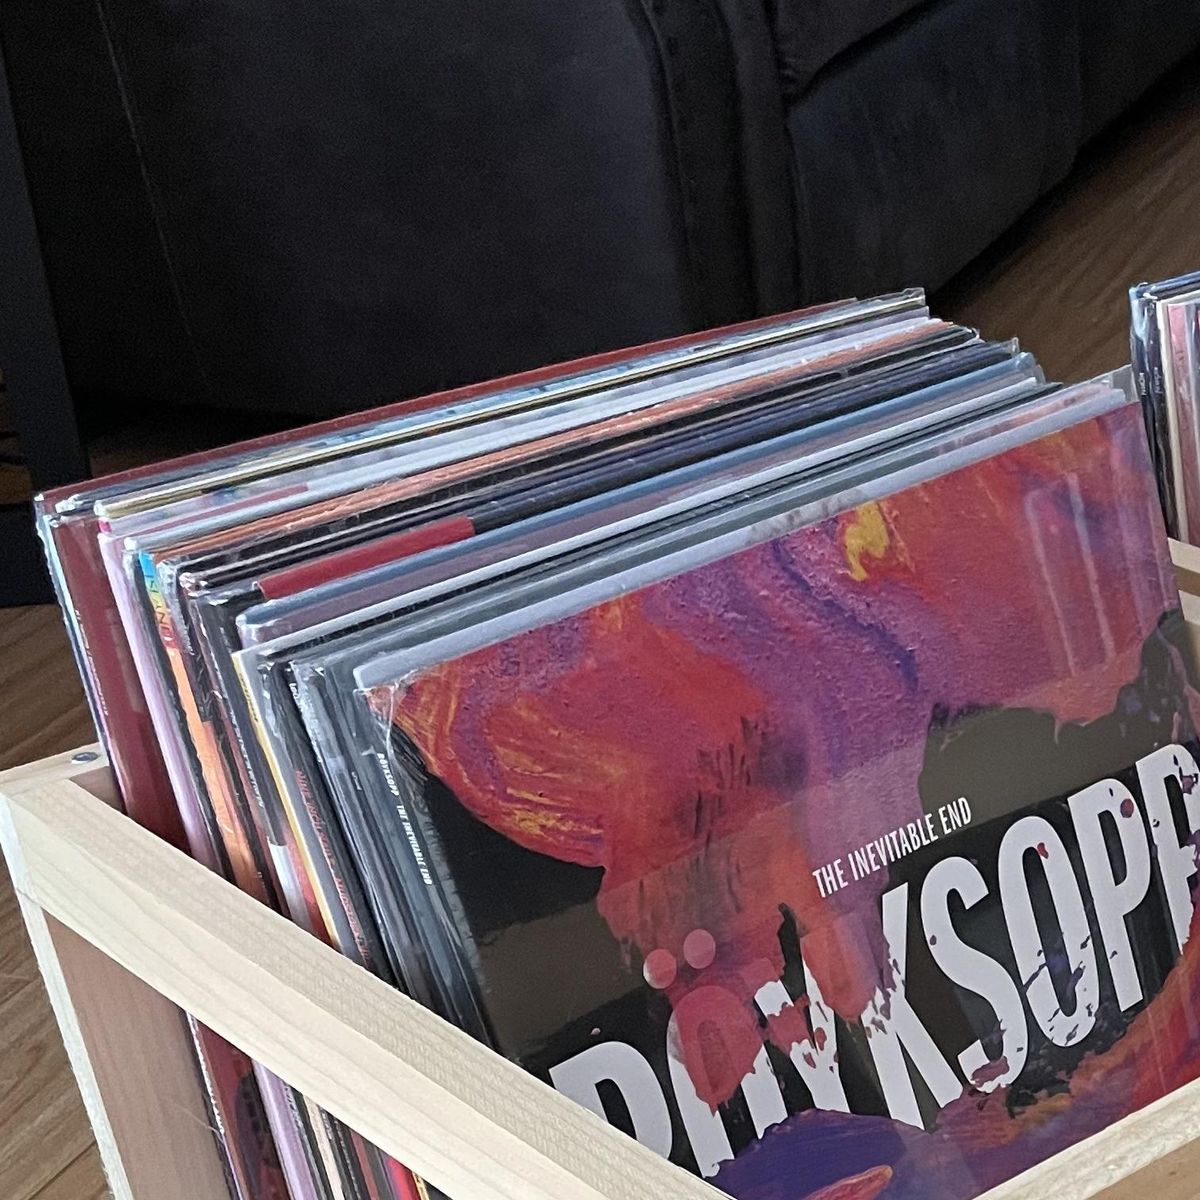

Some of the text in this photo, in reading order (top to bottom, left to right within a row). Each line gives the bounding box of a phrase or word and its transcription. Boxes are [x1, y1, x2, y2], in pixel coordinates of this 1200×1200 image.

[812, 797, 972, 898] THE INEVITABLE END
